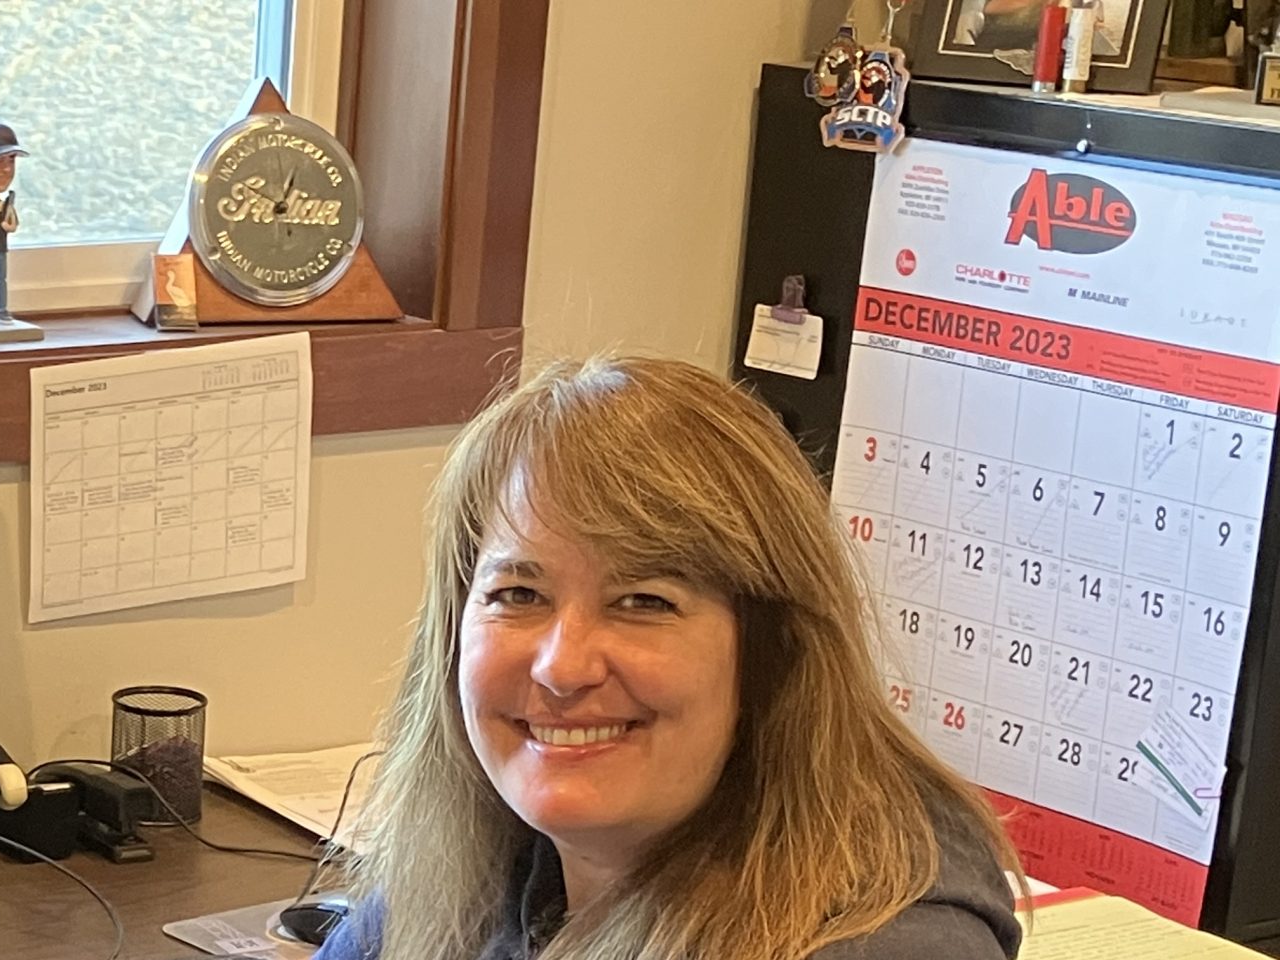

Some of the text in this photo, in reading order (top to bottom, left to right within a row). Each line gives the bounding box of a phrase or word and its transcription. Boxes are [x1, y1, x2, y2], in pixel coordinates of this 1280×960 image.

[1004, 168, 1131, 250] Able
[216, 230, 251, 272] INDIAN
[865, 296, 1001, 348] DECEMBER
[1011, 324, 1071, 361] 2023
[868, 334, 1264, 425] SUNDAY MONDAY TUESDAY WEDNESDAY THURSDAY FRIDAY SATURDAY
[1166, 419, 1241, 459] 1 2
[864, 438, 1230, 546] 3 4 5 6 7 8 9
[849, 516, 1225, 635] 10 11 12 13 14 15 16
[900, 608, 1213, 721] 18 19 20 21 22 23
[943, 703, 965, 729] 26
[999, 721, 1023, 747] 27
[1057, 739, 1081, 766] 28
